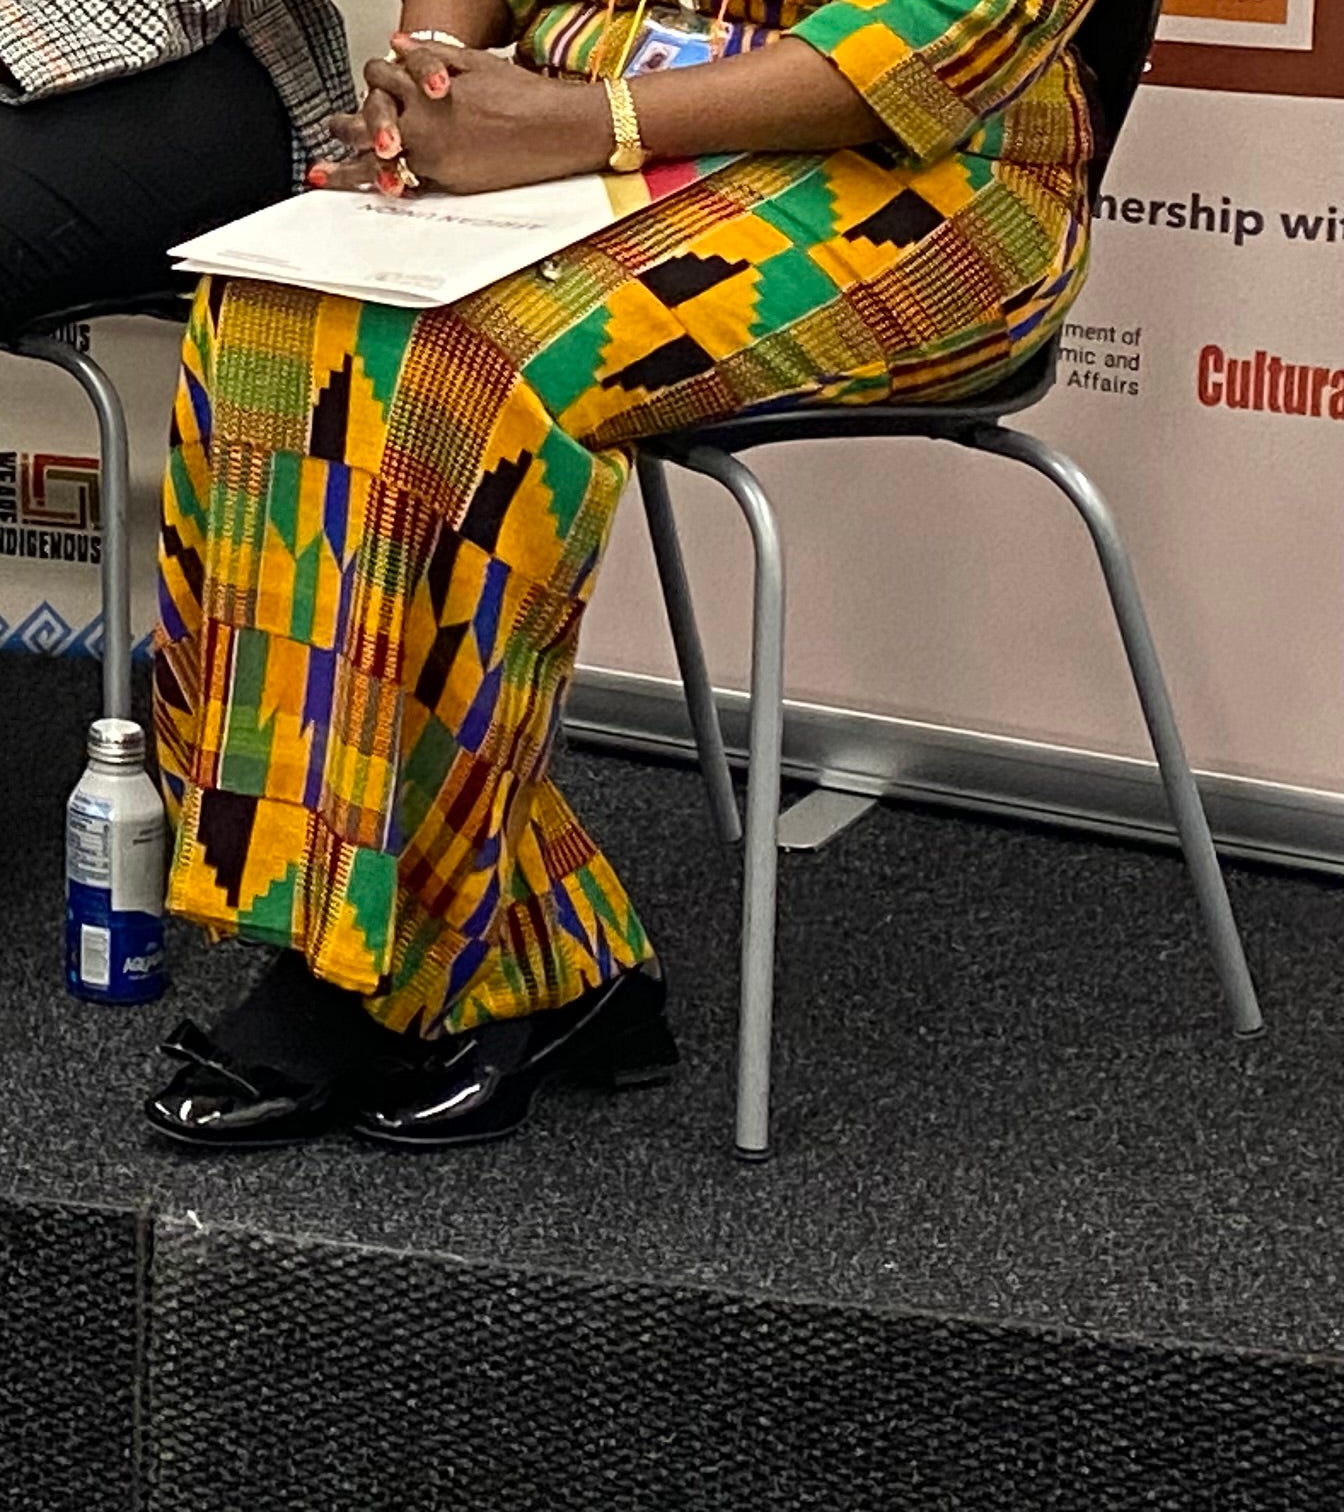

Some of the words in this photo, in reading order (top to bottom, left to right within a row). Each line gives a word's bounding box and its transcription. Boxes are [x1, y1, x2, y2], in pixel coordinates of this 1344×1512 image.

[1280, 206, 1344, 243] wi
[1122, 328, 1142, 346] of
[1104, 353, 1140, 371] and
[1067, 370, 1139, 396] Affairs
